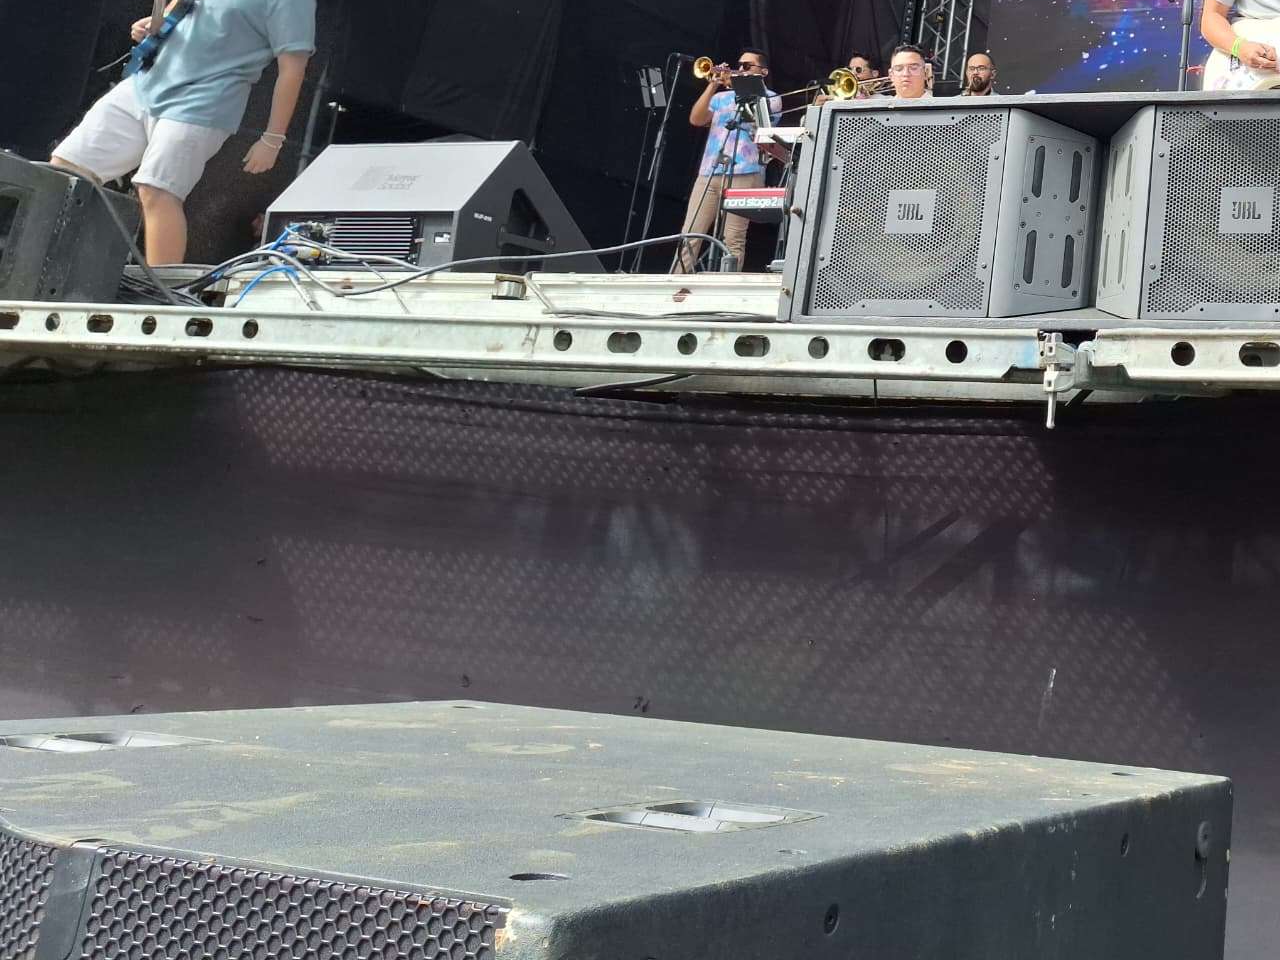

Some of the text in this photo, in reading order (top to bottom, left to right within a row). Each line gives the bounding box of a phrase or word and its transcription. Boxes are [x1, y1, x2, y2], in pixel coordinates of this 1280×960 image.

[723, 197, 746, 207] nord
[1231, 201, 1262, 220] JBL
[897, 203, 924, 221] JBL
